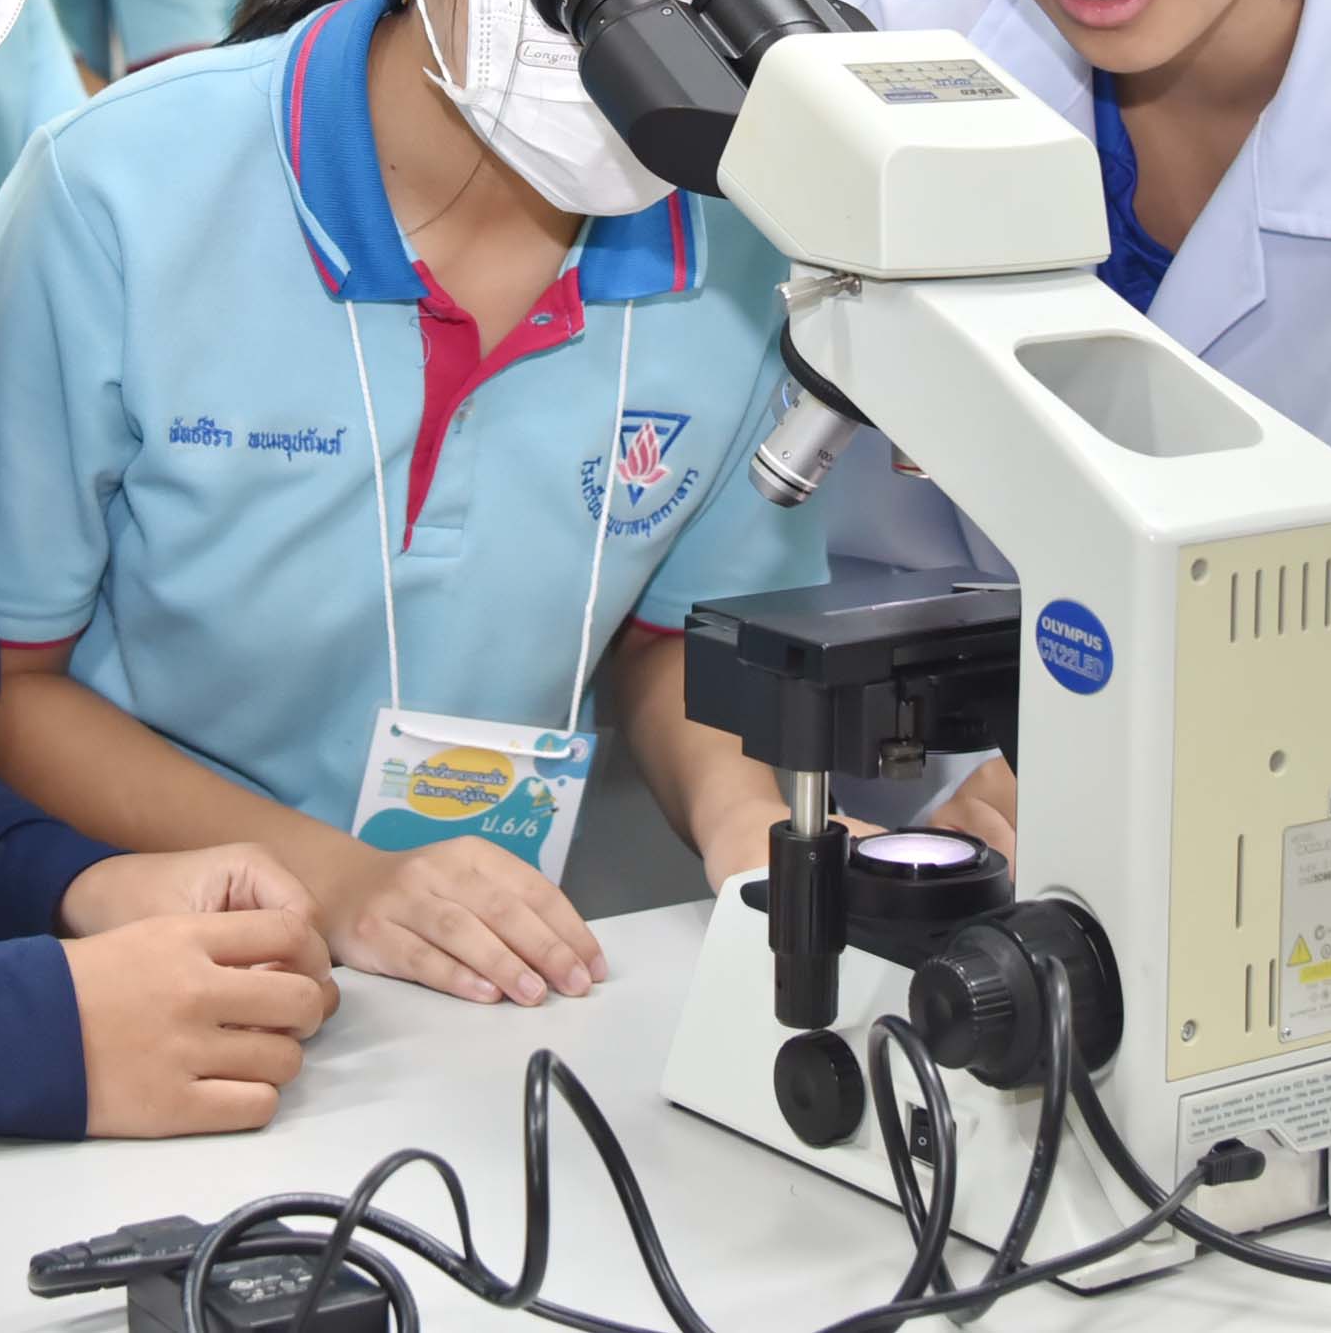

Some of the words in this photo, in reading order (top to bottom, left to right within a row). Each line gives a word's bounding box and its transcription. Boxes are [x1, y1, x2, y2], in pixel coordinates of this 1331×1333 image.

[1041, 616, 1103, 651] OLYMPUS
[1039, 637, 1105, 681] CX22LED
[481, 815, 539, 838] ป.6/6
